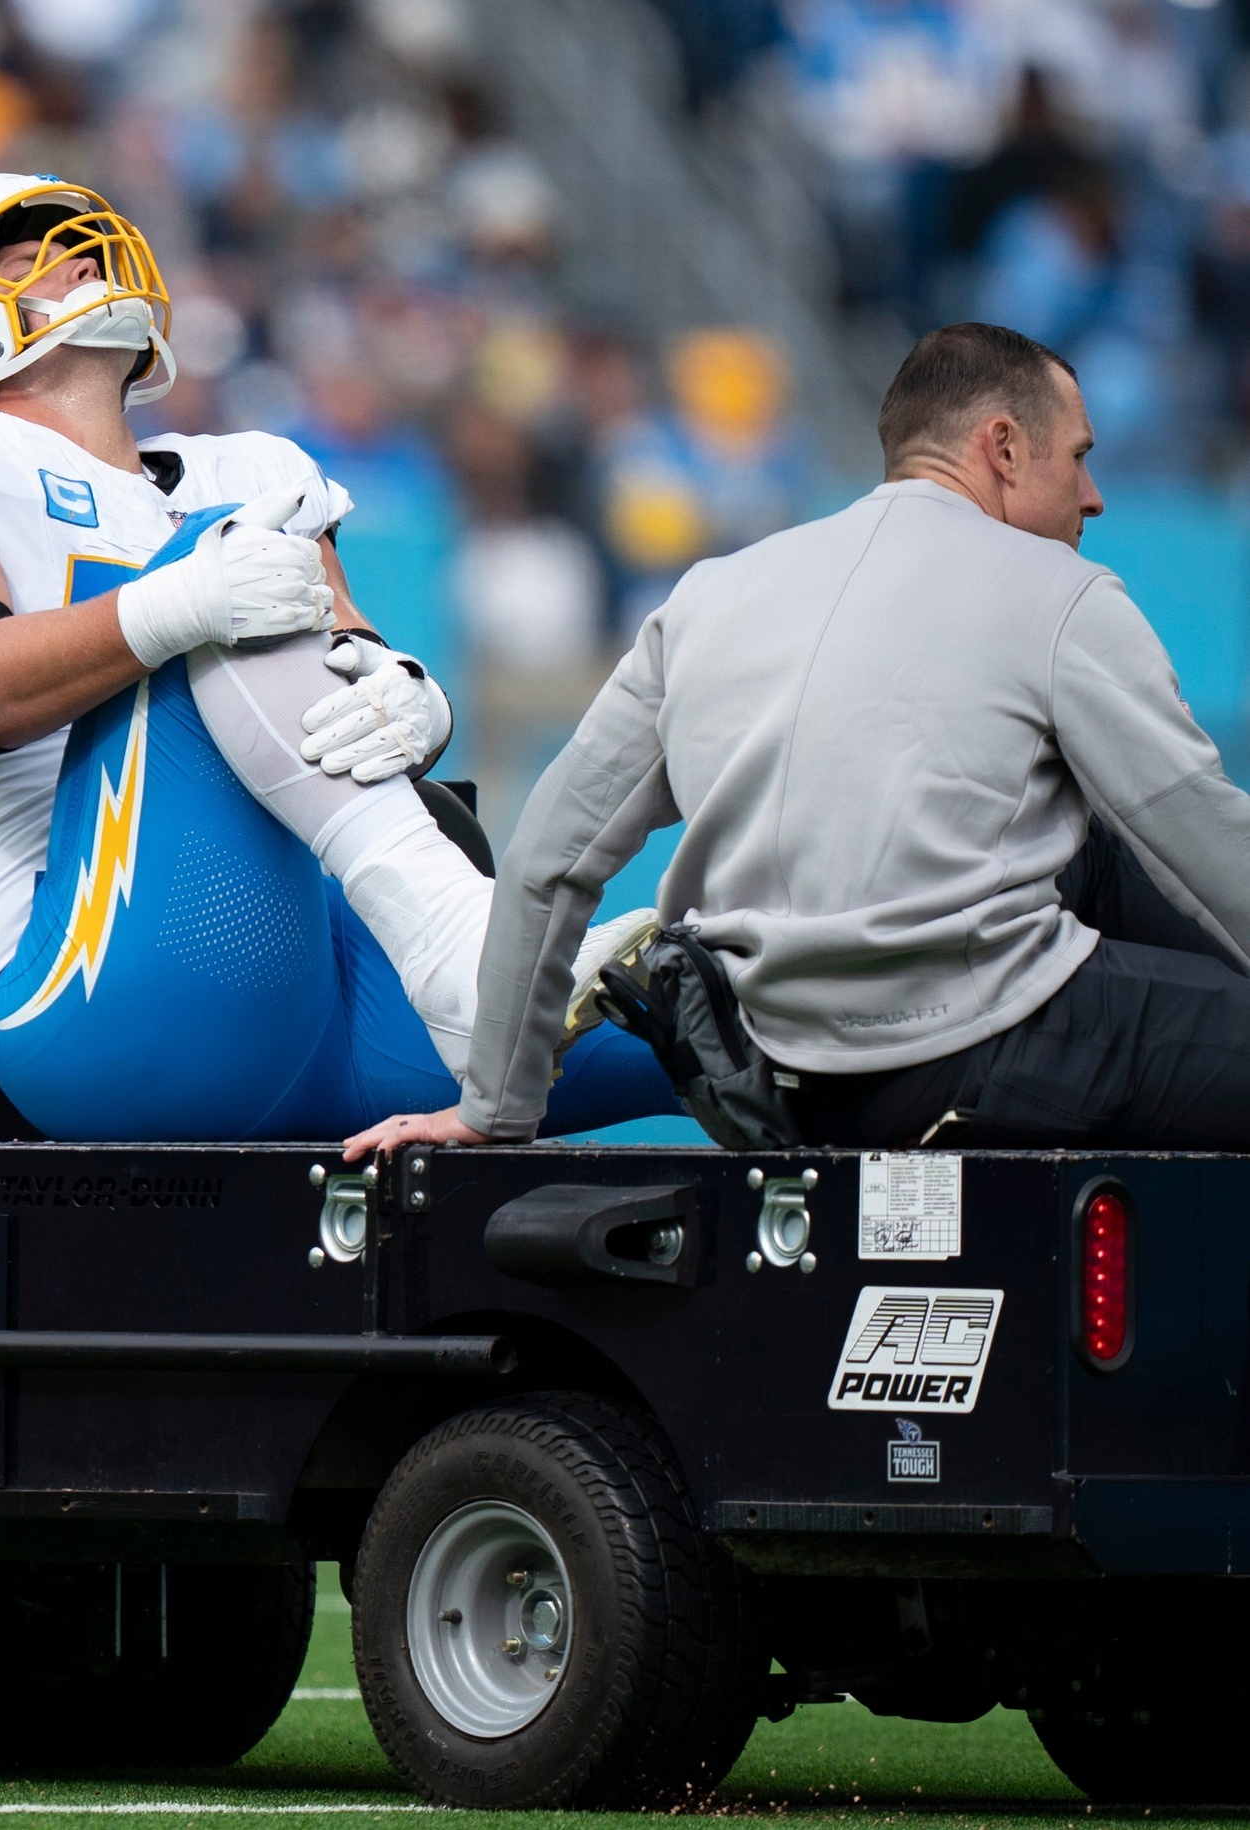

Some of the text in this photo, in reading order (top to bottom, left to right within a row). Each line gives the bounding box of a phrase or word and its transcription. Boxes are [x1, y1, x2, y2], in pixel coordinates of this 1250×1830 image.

[1, 1176, 223, 1209] TAYLOR-DUNN
[845, 1294, 994, 1365] AC
[836, 1373, 973, 1404] POWER
[893, 1447, 935, 1457] TENNESSEE
[893, 1458, 935, 1476] TOUGH
[470, 1450, 591, 1553] CARLISLE
